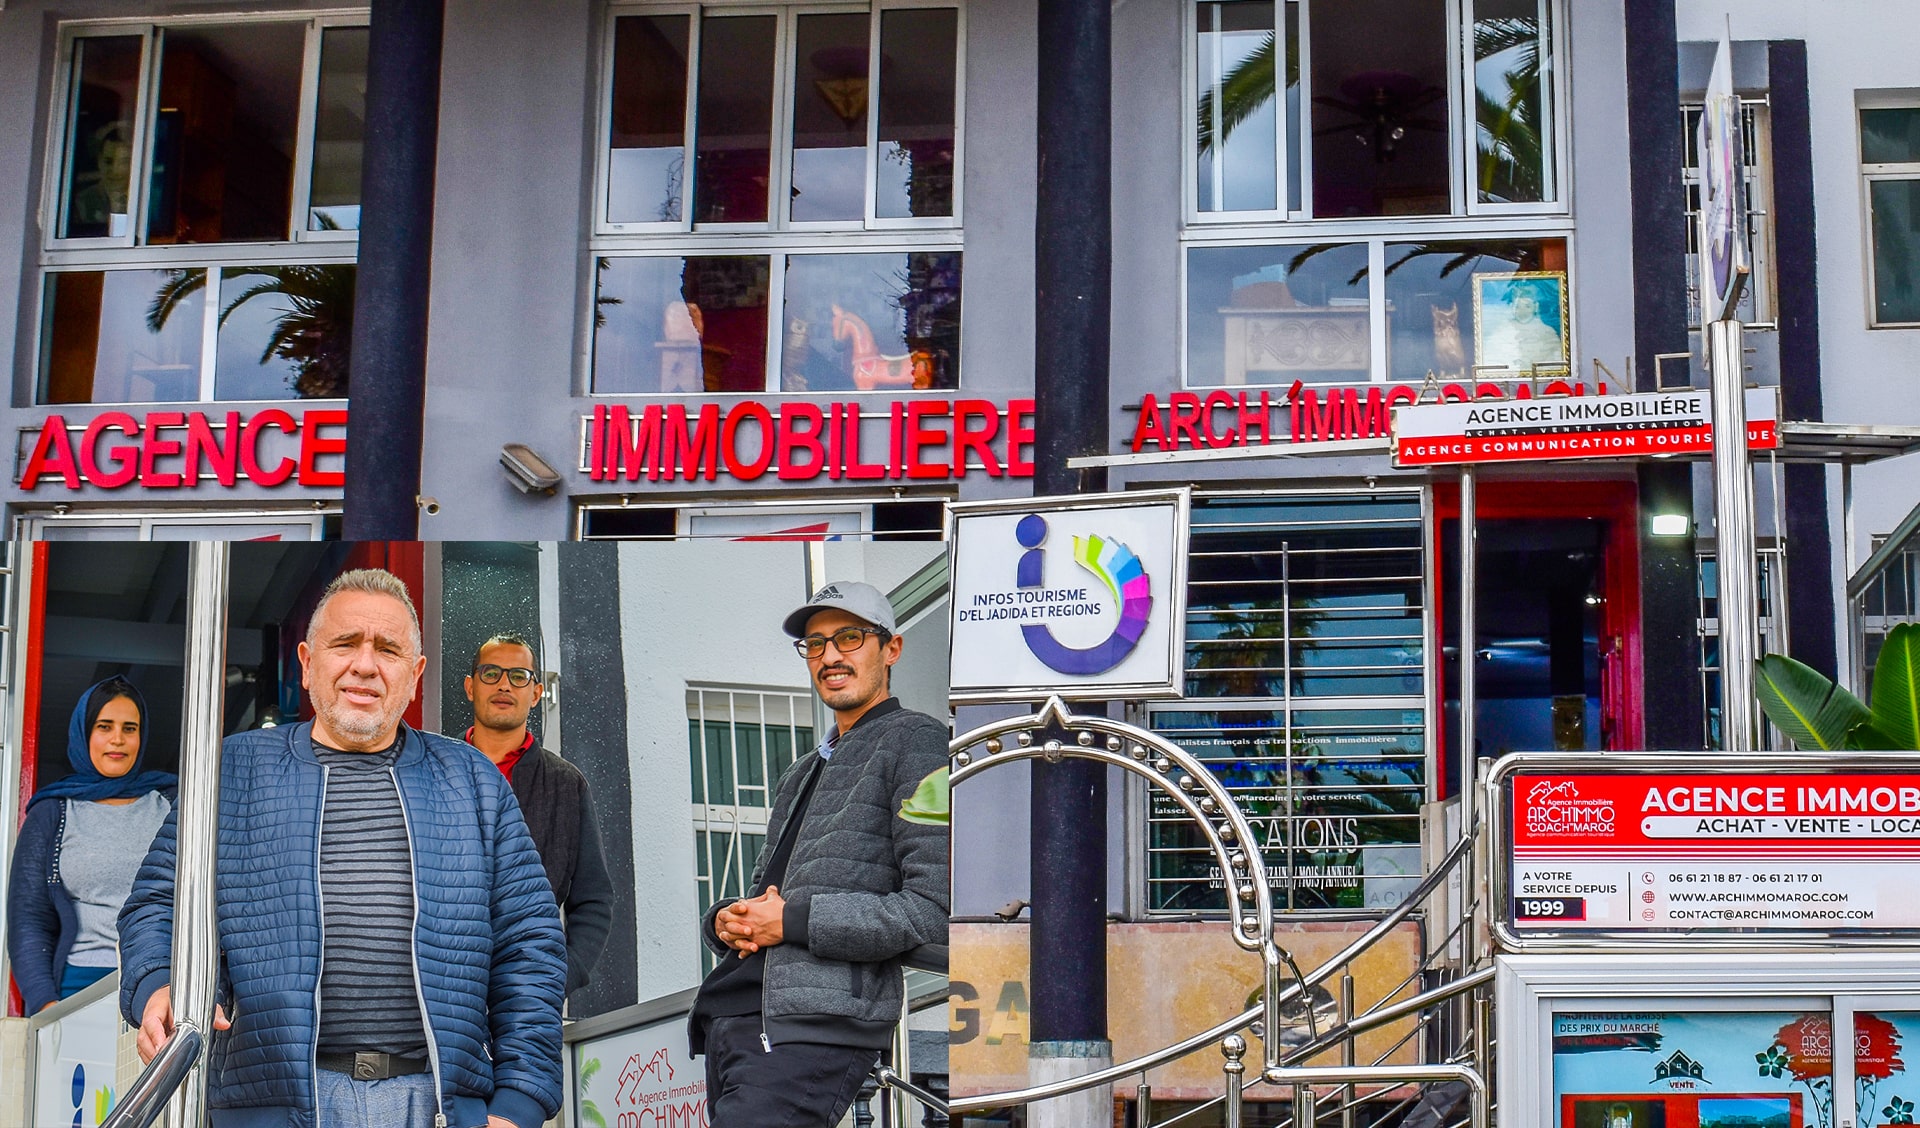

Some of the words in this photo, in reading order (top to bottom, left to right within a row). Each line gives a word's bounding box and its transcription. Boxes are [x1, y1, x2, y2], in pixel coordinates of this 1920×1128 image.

[1466, 406, 1552, 425] AGENCE
[1559, 396, 1701, 420] IMMOBILIÉRE
[1616, 420, 1703, 430] LOCATION
[590, 399, 1035, 481] IMMOBILIERE
[1405, 444, 1473, 456] AGENCE
[1482, 437, 1635, 452] COMMUNICATION
[1645, 430, 1769, 445] TOURISUE
[20, 409, 348, 490] AGENCE
[973, 592, 1013, 606] INFOS
[1017, 588, 1087, 604] TOURISME
[986, 607, 1028, 621] JADIDA
[1031, 606, 1046, 618] ET
[1048, 603, 1101, 617] REGIONS
[1213, 738, 1250, 747] français
[1273, 736, 1331, 745] trasactions
[1641, 787, 1785, 812] AGENCE
[1797, 787, 1920, 812] IMMOB
[1696, 818, 1765, 832] ACHAT
[1784, 818, 1850, 832] VENTE
[1523, 872, 1531, 880] A
[1534, 872, 1572, 880] VOTRE
[1669, 874, 1683, 883] 06
[1686, 874, 1697, 883] 61
[1700, 874, 1711, 883] 21
[1714, 874, 1724, 883] 18
[1728, 874, 1742, 883] 87
[1752, 874, 1766, 883] 06
[1769, 874, 1781, 883] 61
[1784, 874, 1794, 883] 21
[1797, 874, 1808, 883] 17
[1811, 874, 1823, 883] 01
[1523, 885, 1571, 893] SERVICE
[1574, 885, 1617, 893] DEPUIS
[1669, 893, 1848, 902] WWW.ARCHIMMOMAROC.COM
[1522, 900, 1564, 916] 1999
[1669, 910, 1874, 920] CONTACT@ARCHIMMOMAROC.COM
[1559, 1024, 1577, 1032] DES
[1580, 1023, 1600, 1032] PRIX
[1603, 1023, 1617, 1032] DU
[1619, 1022, 1659, 1032] MARCHÉ
[638, 1092, 667, 1107] Agence
[669, 1080, 708, 1100] Immobili
